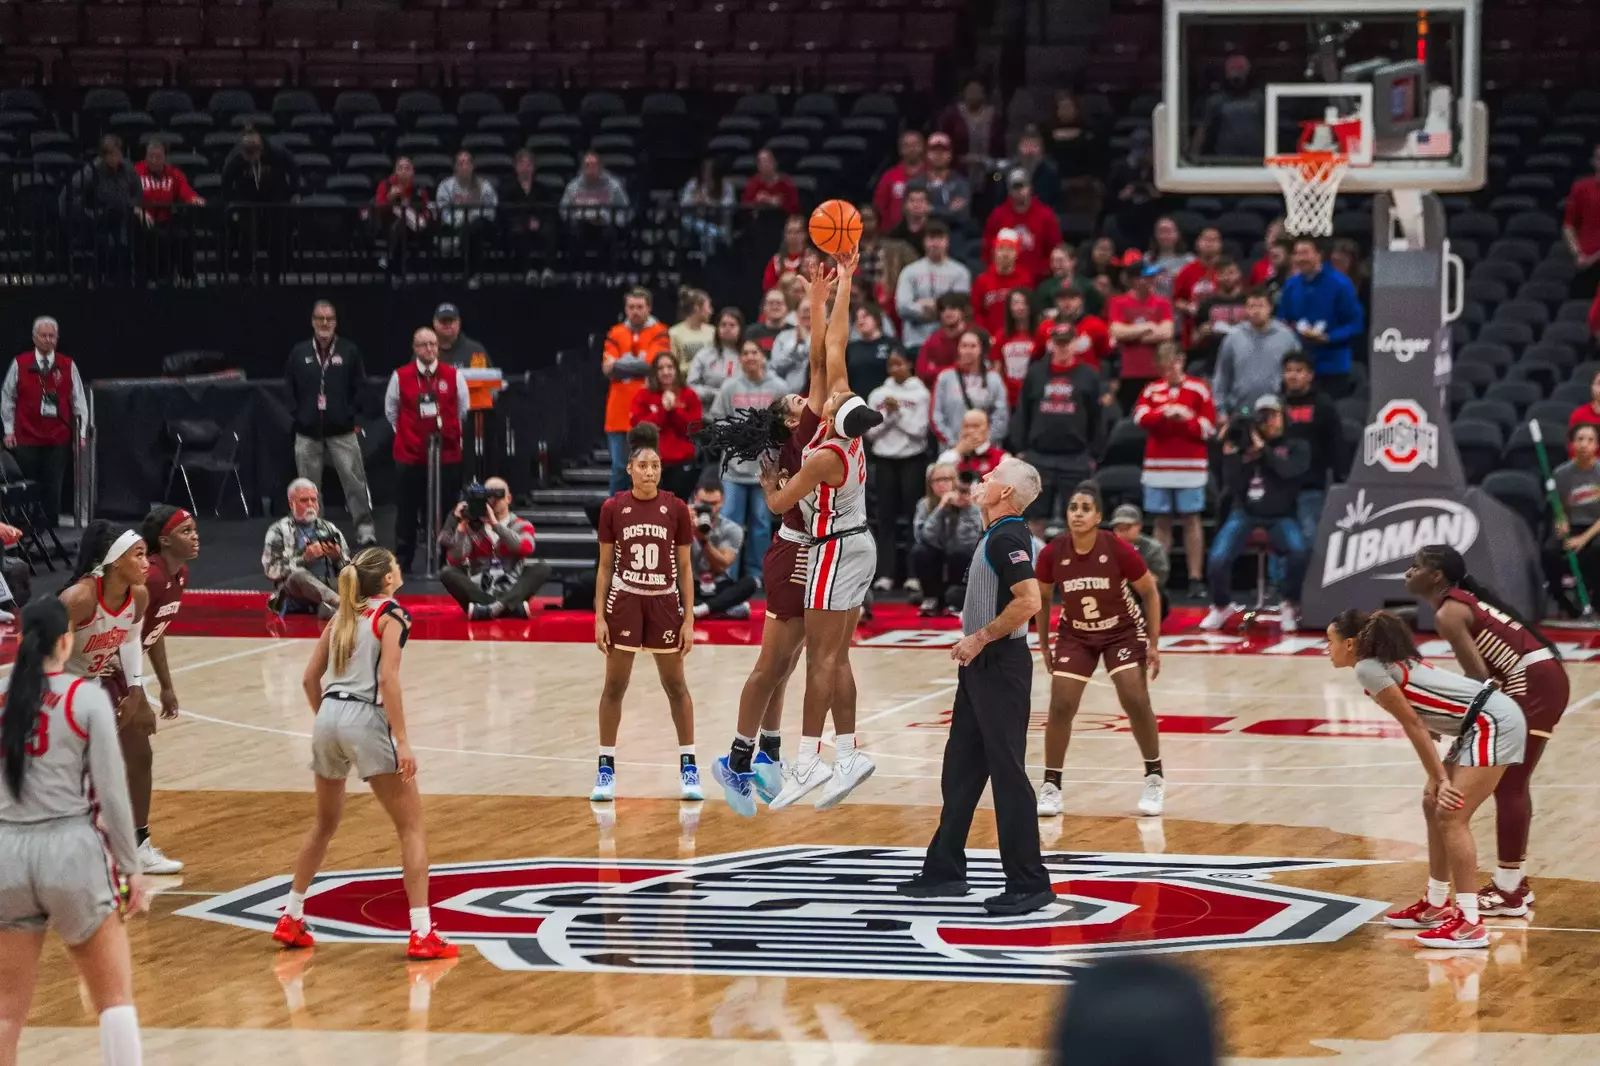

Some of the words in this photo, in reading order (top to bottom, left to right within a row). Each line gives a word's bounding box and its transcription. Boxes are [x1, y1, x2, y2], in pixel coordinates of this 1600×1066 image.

[623, 524, 668, 541] BOSTON
[630, 543, 659, 571] 30
[1322, 513, 1461, 588] LIBMAN
[622, 570, 667, 585] COLLEGE
[1063, 577, 1110, 592] BOSTON
[1081, 596, 1100, 619] 2
[1072, 615, 1119, 631] COLLEGE
